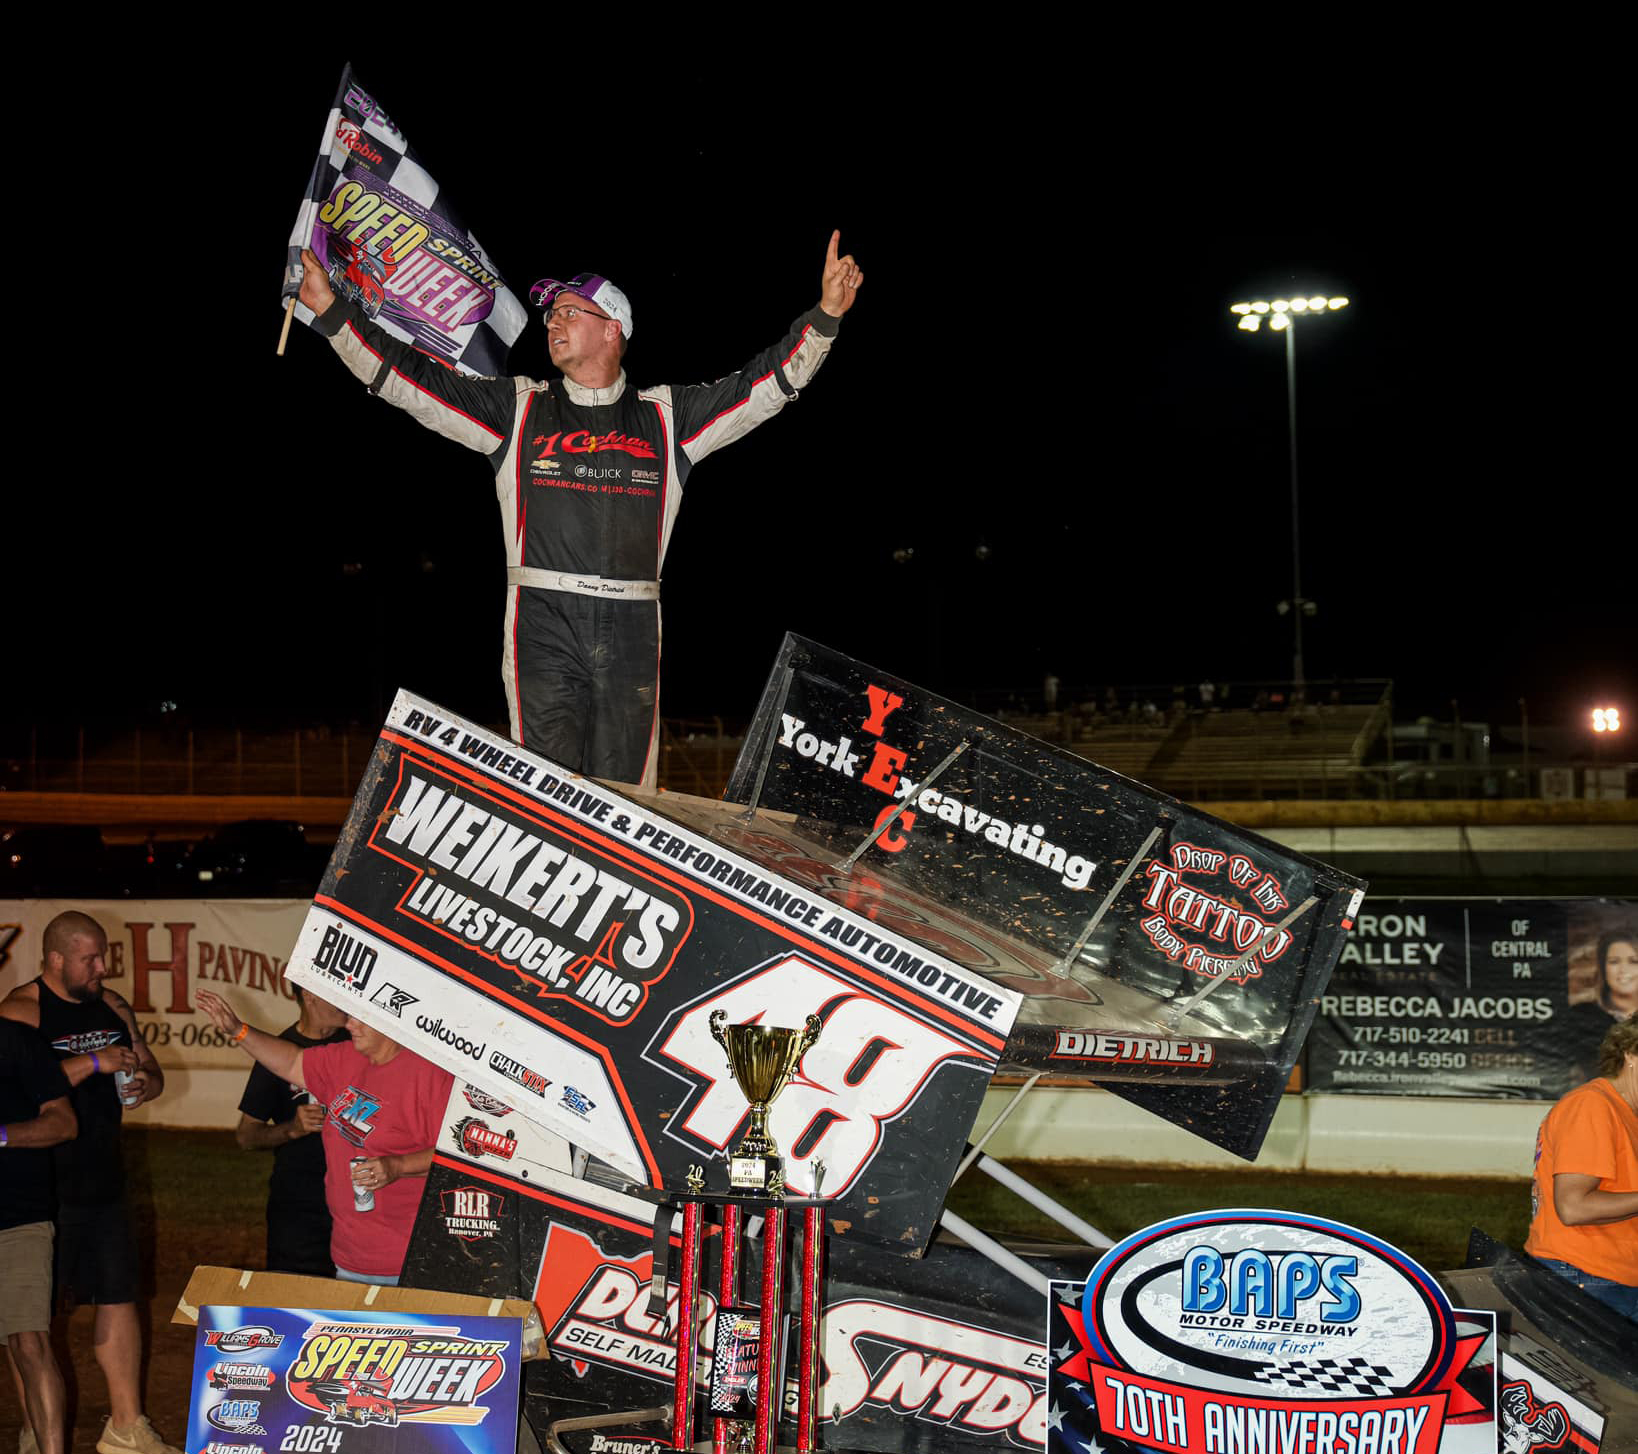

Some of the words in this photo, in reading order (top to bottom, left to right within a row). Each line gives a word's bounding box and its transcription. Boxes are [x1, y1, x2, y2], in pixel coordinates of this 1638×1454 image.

[319, 180, 431, 265] SPEED
[427, 238, 502, 290] SPRINT
[384, 249, 489, 328] WEEK
[587, 467, 622, 479] BUICK
[778, 713, 860, 778] York
[385, 775, 681, 970] WEIKERT'S
[403, 708, 442, 737] RV
[438, 727, 459, 747] 4
[458, 733, 537, 787] WHEEL
[536, 773, 615, 825] DRIVE
[611, 814, 633, 834] &
[633, 822, 823, 928] PERFORMANCE
[818, 915, 1004, 1021] AUTOMOTIVE
[1511, 919, 1530, 937] OF
[407, 878, 577, 985] LIVESTOCK,
[576, 964, 642, 1017] INC
[1339, 942, 1444, 965] ALLEY
[1491, 941, 1551, 958] CENTRAL
[124, 922, 196, 1014] H
[1512, 962, 1532, 979] PA
[1320, 996, 1443, 1018] REBECCA
[1448, 997, 1553, 1020] JACOBS
[415, 1014, 487, 1061] wilwood
[1055, 1031, 1214, 1064] DIETRICH
[1353, 1026, 1470, 1045] 717-510-2241
[1337, 1050, 1467, 1069] 717-344-5950
[658, 956, 990, 1199] 48
[453, 1190, 490, 1218] RLR
[1181, 1244, 1362, 1324] BAPS
[319, 1325, 415, 1337] PENNSYLVANIA
[1179, 1314, 1245, 1329] MOTOR
[1255, 1320, 1359, 1337] SPEEDWAY
[410, 1340, 508, 1356] SPRINT
[565, 1327, 625, 1353] SELF
[215, 1362, 270, 1377] Lincoln
[296, 1336, 409, 1382] SPEED
[227, 1376, 268, 1387] Speedway
[388, 1357, 497, 1402] WEEK
[220, 1401, 259, 1418] BAPS
[1105, 1377, 1188, 1448] 70TH
[1204, 1401, 1431, 1454] ANNIVERSARY
[206, 1442, 264, 1454] Lincoln
[279, 1425, 345, 1454] 2024
[589, 1435, 662, 1454] Bruner's
